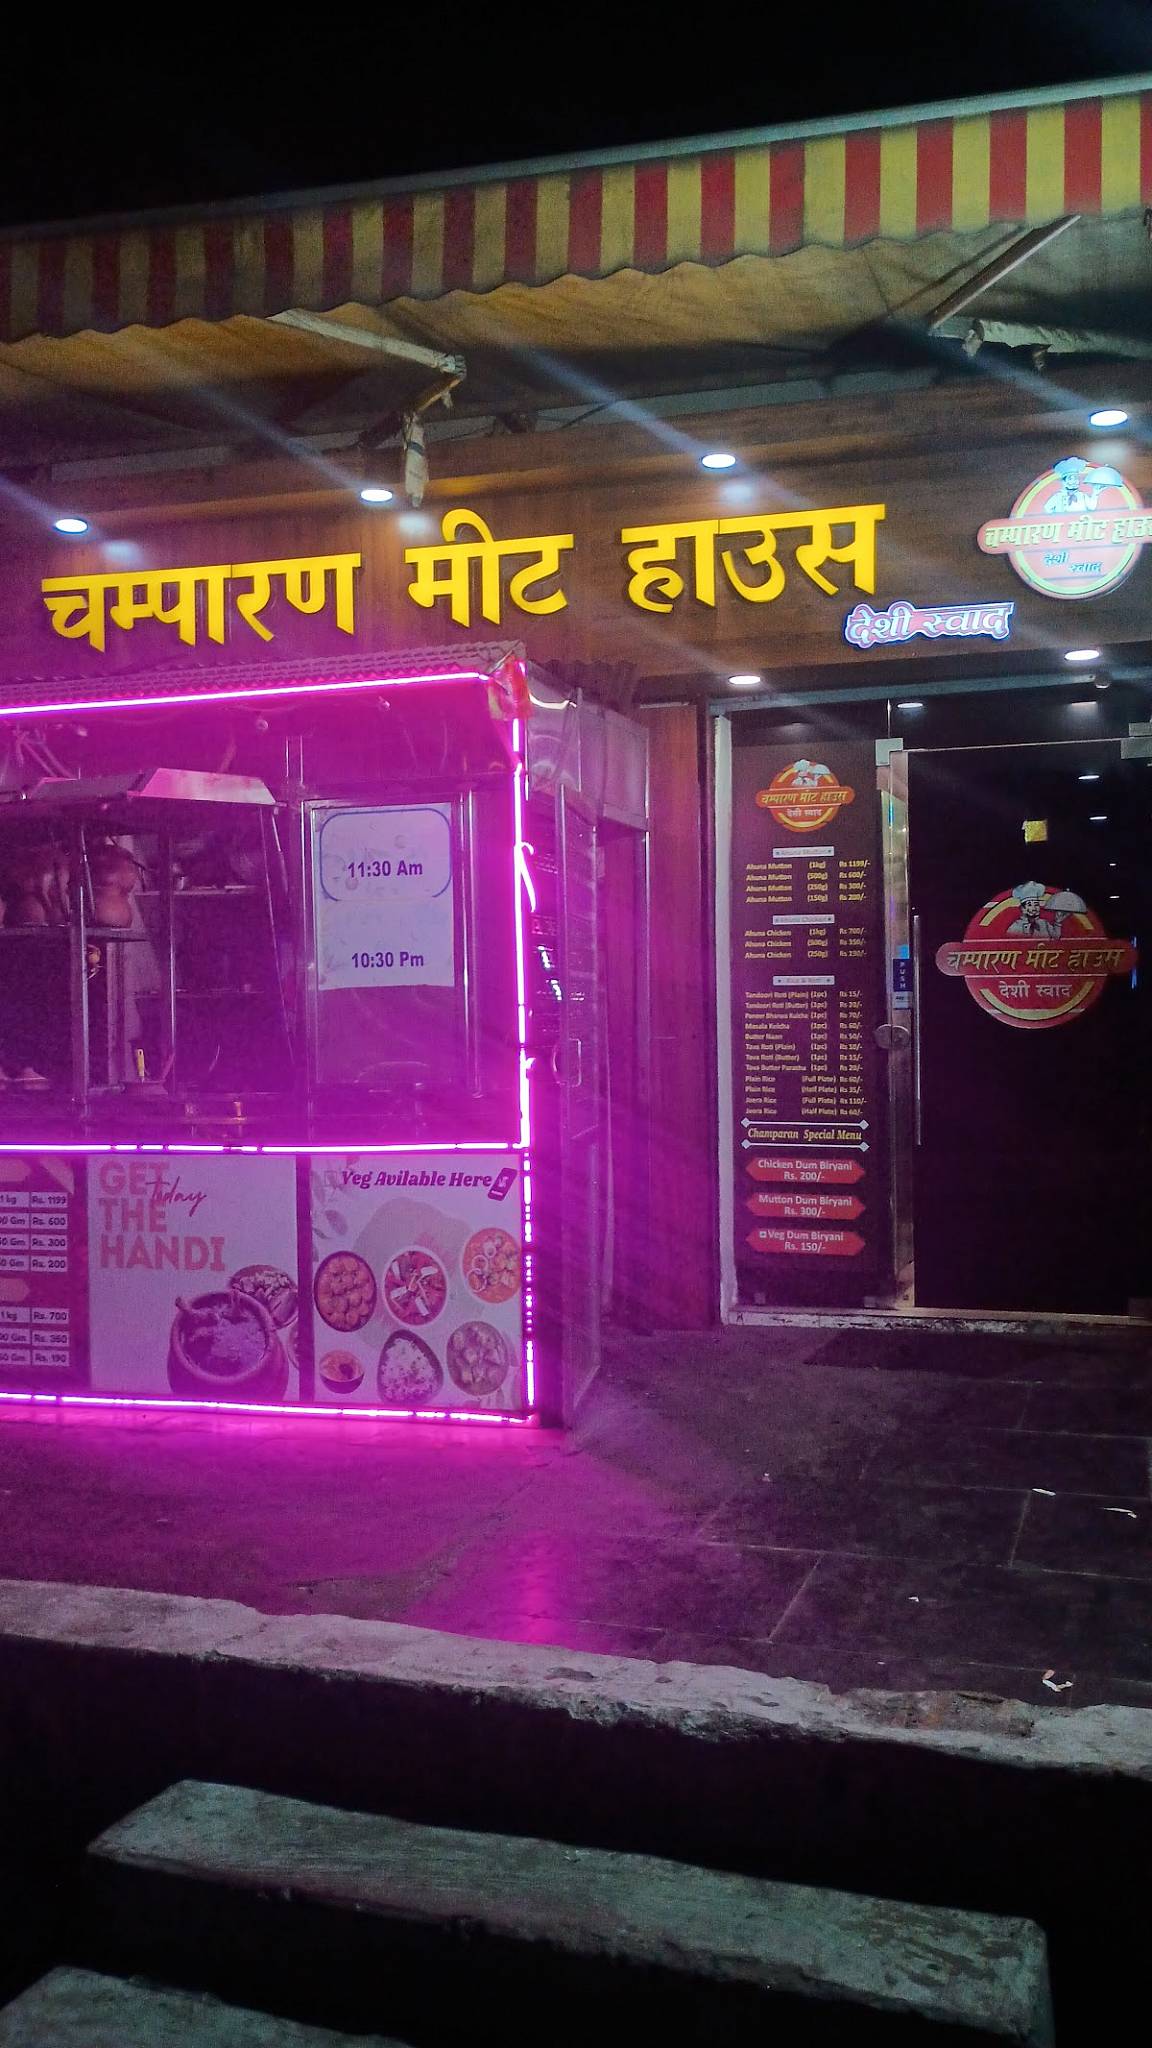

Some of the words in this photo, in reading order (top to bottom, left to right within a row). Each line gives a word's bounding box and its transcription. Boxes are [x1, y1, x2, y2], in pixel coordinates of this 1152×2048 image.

[1068, 515, 1109, 542] मीट
[1112, 517, 1152, 544] हाउ
[41, 552, 362, 652] चम्पारण
[404, 508, 575, 628] मीट
[621, 503, 885, 613] हाउस
[848, 604, 914, 644] देशी
[922, 605, 1010, 634] स्वाद
[348, 861, 391, 877] 11:30
[396, 860, 423, 876] Am
[351, 952, 394, 968] 10:30
[400, 951, 424, 967] Pm
[947, 950, 1022, 973] चम्पारण
[1025, 943, 1065, 969] मीट
[999, 980, 1031, 999] देशी
[1035, 984, 1072, 998] स्वाद
[748, 1128, 799, 1140] Champaran
[803, 1128, 835, 1141] Special
[836, 1129, 862, 1140] Menu
[758, 1160, 794, 1169] Chicken
[795, 1160, 817, 1170] Dum
[820, 1161, 852, 1172] Biryani
[101, 1160, 170, 1196] GET
[341, 1170, 374, 1190] Veg
[375, 1170, 446, 1187] Avilable
[449, 1172, 492, 1187] Here
[784, 1172, 798, 1180] Rs.
[800, 1171, 825, 1182] 200/-
[47, 1196, 66, 1204] 1199
[758, 1195, 794, 1204] Mutton
[795, 1195, 817, 1205] Dum
[820, 1196, 852, 1207] Biryani
[99, 1198, 168, 1232] THE
[784, 1207, 798, 1215] Rs.
[800, 1207, 826, 1218] 300/-
[48, 1217, 66, 1225] 600
[47, 1238, 66, 1247] 300
[767, 1231, 785, 1241] Veg
[787, 1231, 809, 1240] Dum
[811, 1232, 844, 1242] Biryani
[99, 1234, 226, 1271] HANDI
[784, 1242, 798, 1250] Rs.
[800, 1242, 826, 1253] 150/-
[48, 1260, 66, 1268] 200
[49, 1312, 67, 1321] 700
